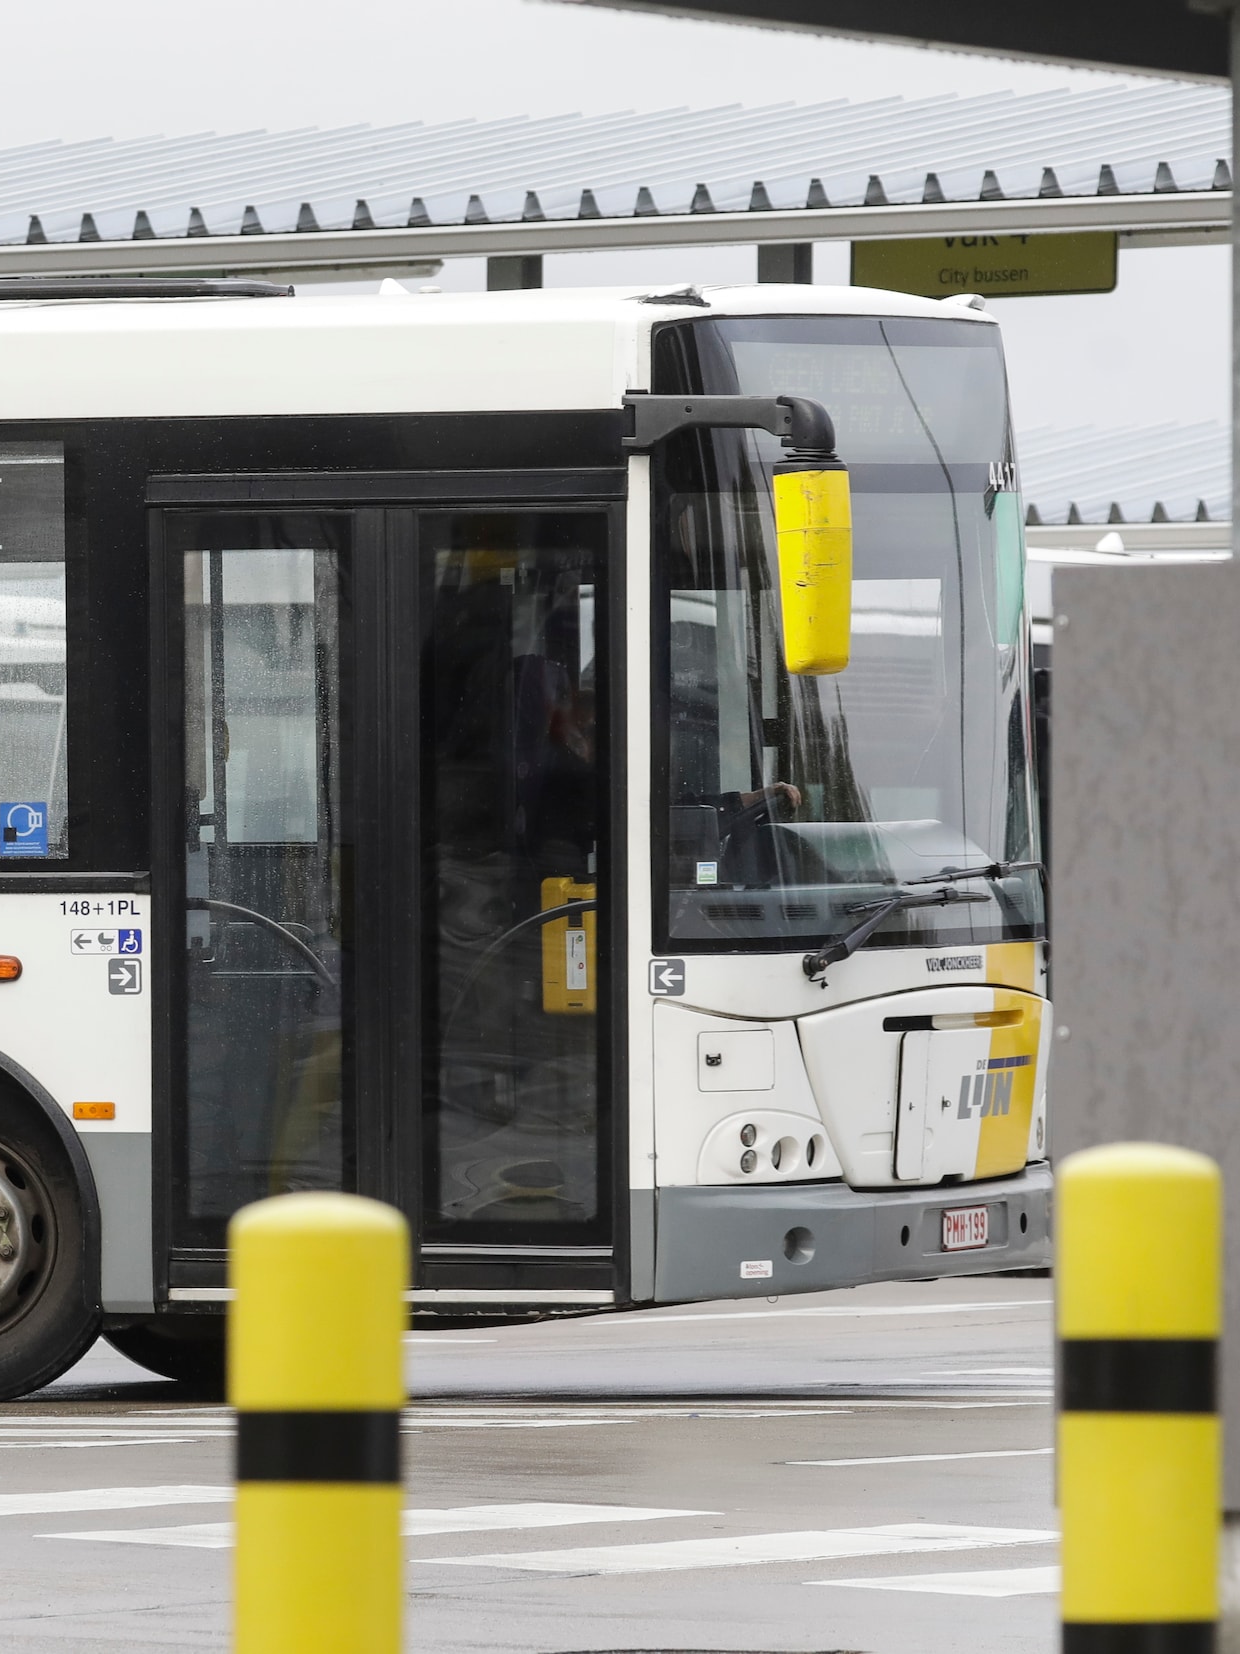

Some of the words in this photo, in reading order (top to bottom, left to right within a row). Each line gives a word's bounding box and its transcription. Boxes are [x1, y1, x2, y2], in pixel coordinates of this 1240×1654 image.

[939, 268, 968, 287] City
[974, 267, 1029, 281] bussen
[989, 461, 1017, 491] 4417
[60, 900, 141, 915] 148+1PL
[976, 1059, 987, 1070] DE
[957, 1071, 1014, 1120] LIJN
[946, 1211, 985, 1244] PMH-199
